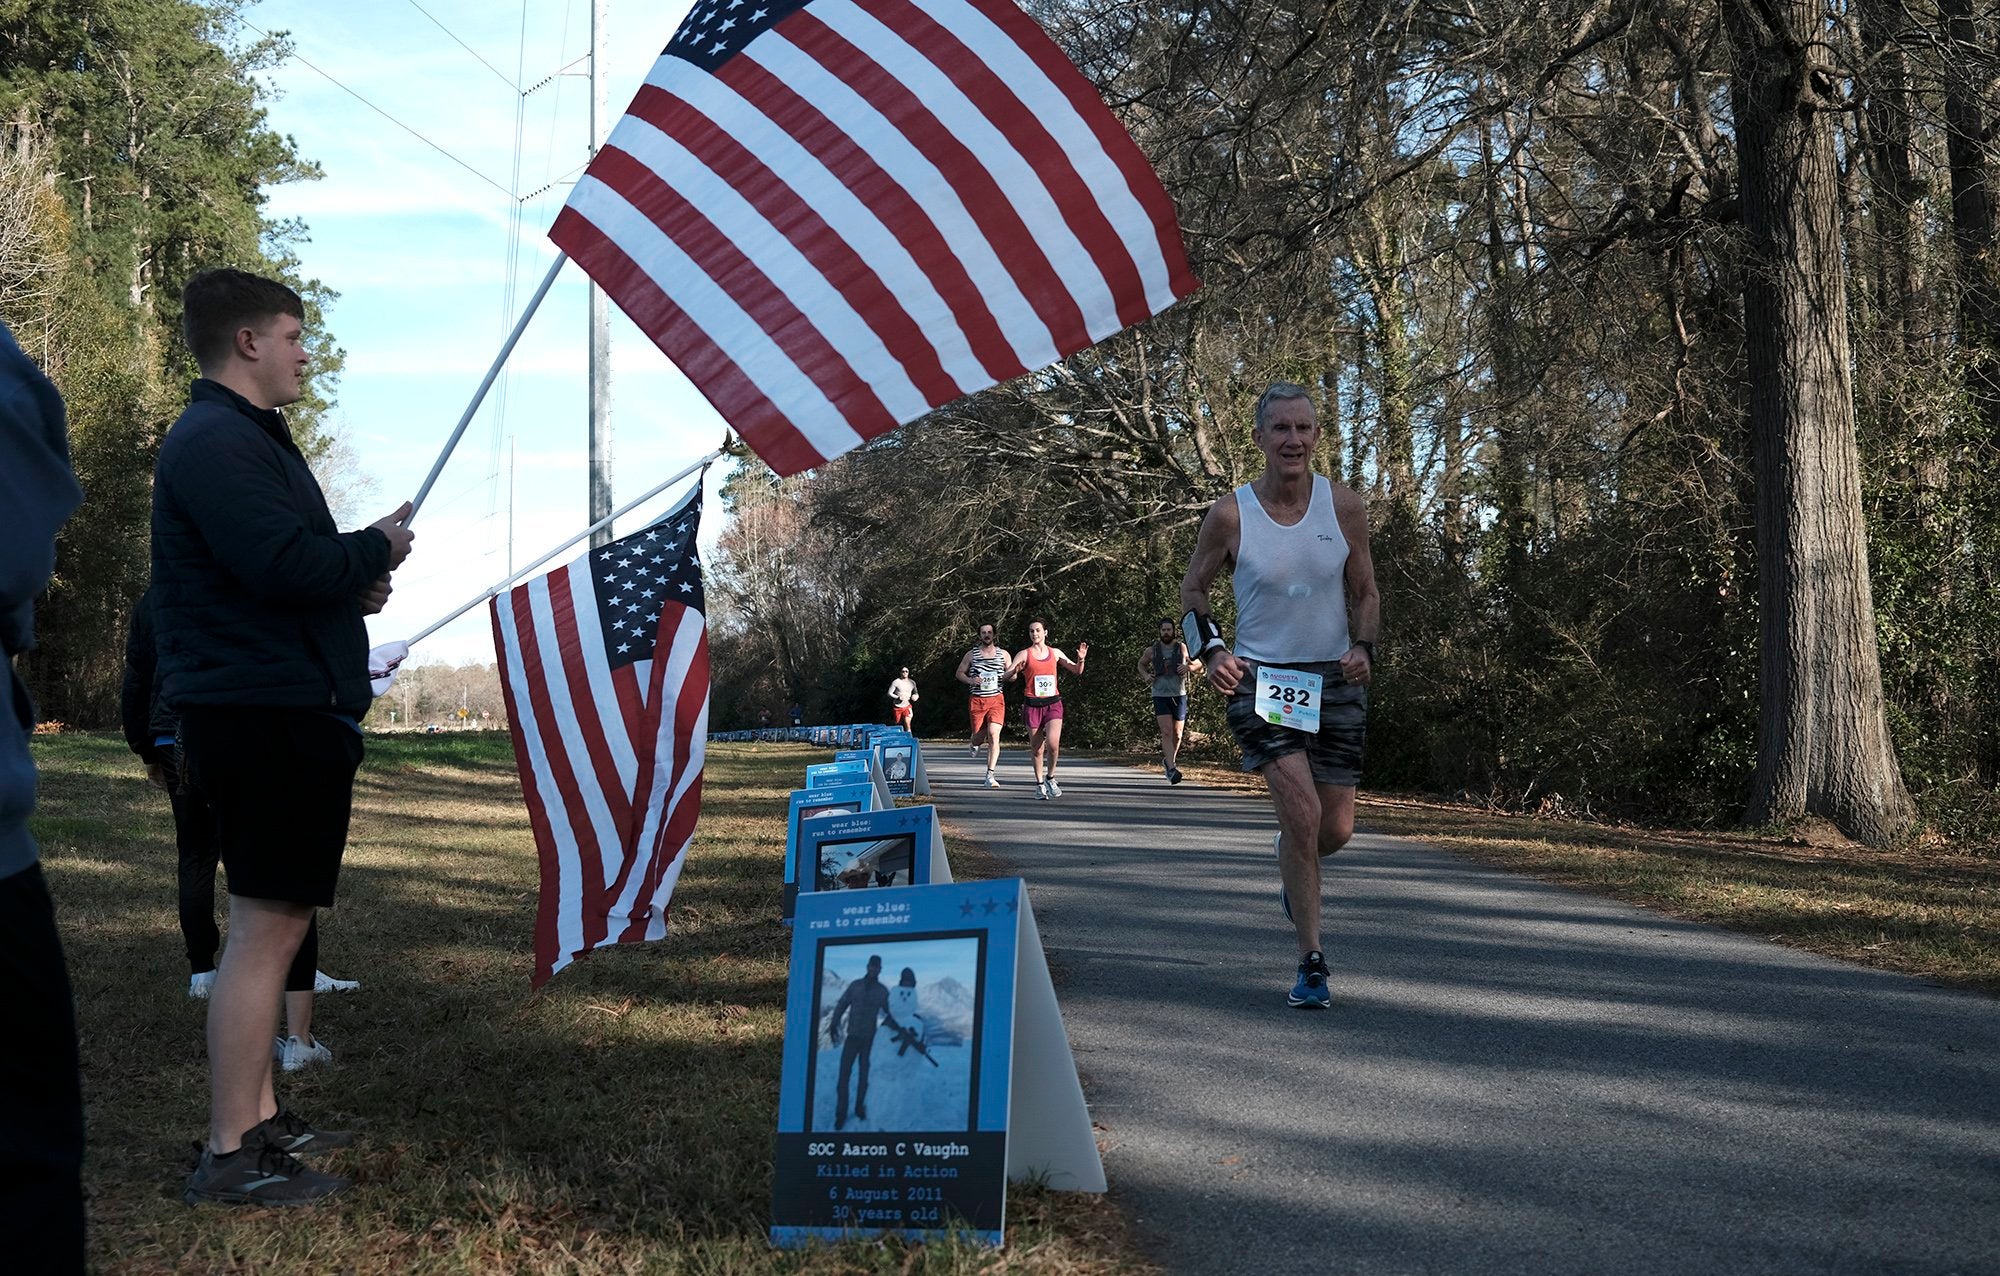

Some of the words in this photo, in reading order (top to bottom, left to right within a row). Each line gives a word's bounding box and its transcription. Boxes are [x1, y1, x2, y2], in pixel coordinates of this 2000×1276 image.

[1268, 684, 1310, 707] 282
[838, 826, 872, 835] remember
[852, 819, 871, 827] blue:
[842, 905, 872, 915] wear
[877, 902, 911, 913] blue:
[810, 920, 831, 929] run
[836, 918, 850, 928] to
[854, 914, 911, 927] remember
[808, 1142, 835, 1156] SOC
[842, 1142, 888, 1156] Aaron
[895, 1142, 906, 1156] C
[913, 1142, 969, 1160] Vaughn
[816, 1164, 870, 1178] Killed
[878, 1164, 896, 1178] in
[903, 1164, 958, 1178] Action
[829, 1186, 838, 1200] 6
[845, 1186, 899, 1204] August
[907, 1187, 943, 1201] 2011
[832, 1205, 849, 1219] 30
[858, 1208, 902, 1223] years
[910, 1206, 938, 1220] old
